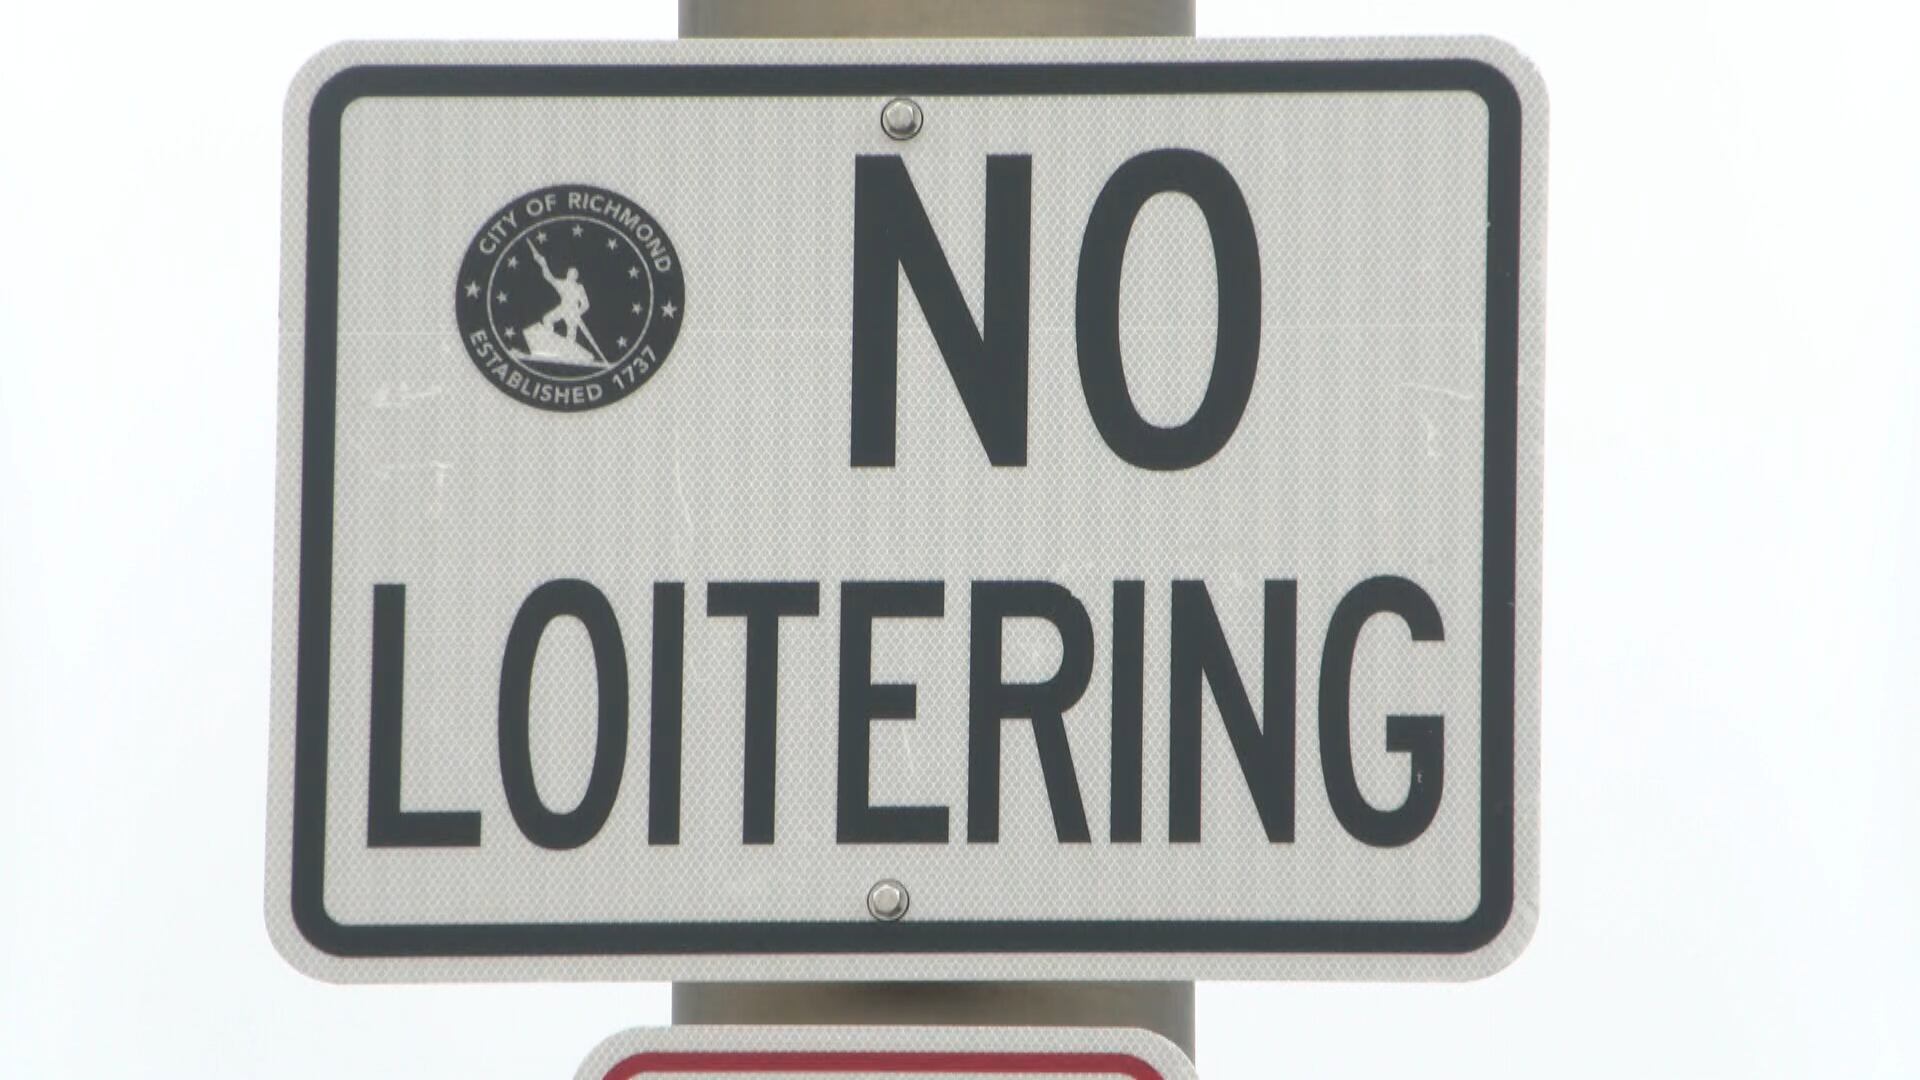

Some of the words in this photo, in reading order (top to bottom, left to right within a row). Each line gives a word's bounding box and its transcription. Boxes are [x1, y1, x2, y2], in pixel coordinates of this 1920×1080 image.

[479, 211, 518, 254] CITY
[526, 194, 557, 216] OF
[568, 191, 672, 272] RICHMOND
[850, 148, 1262, 471] NO
[469, 329, 603, 404] ESTABLISHED
[612, 345, 657, 389] 1737
[367, 575, 1446, 850] LOITERING
